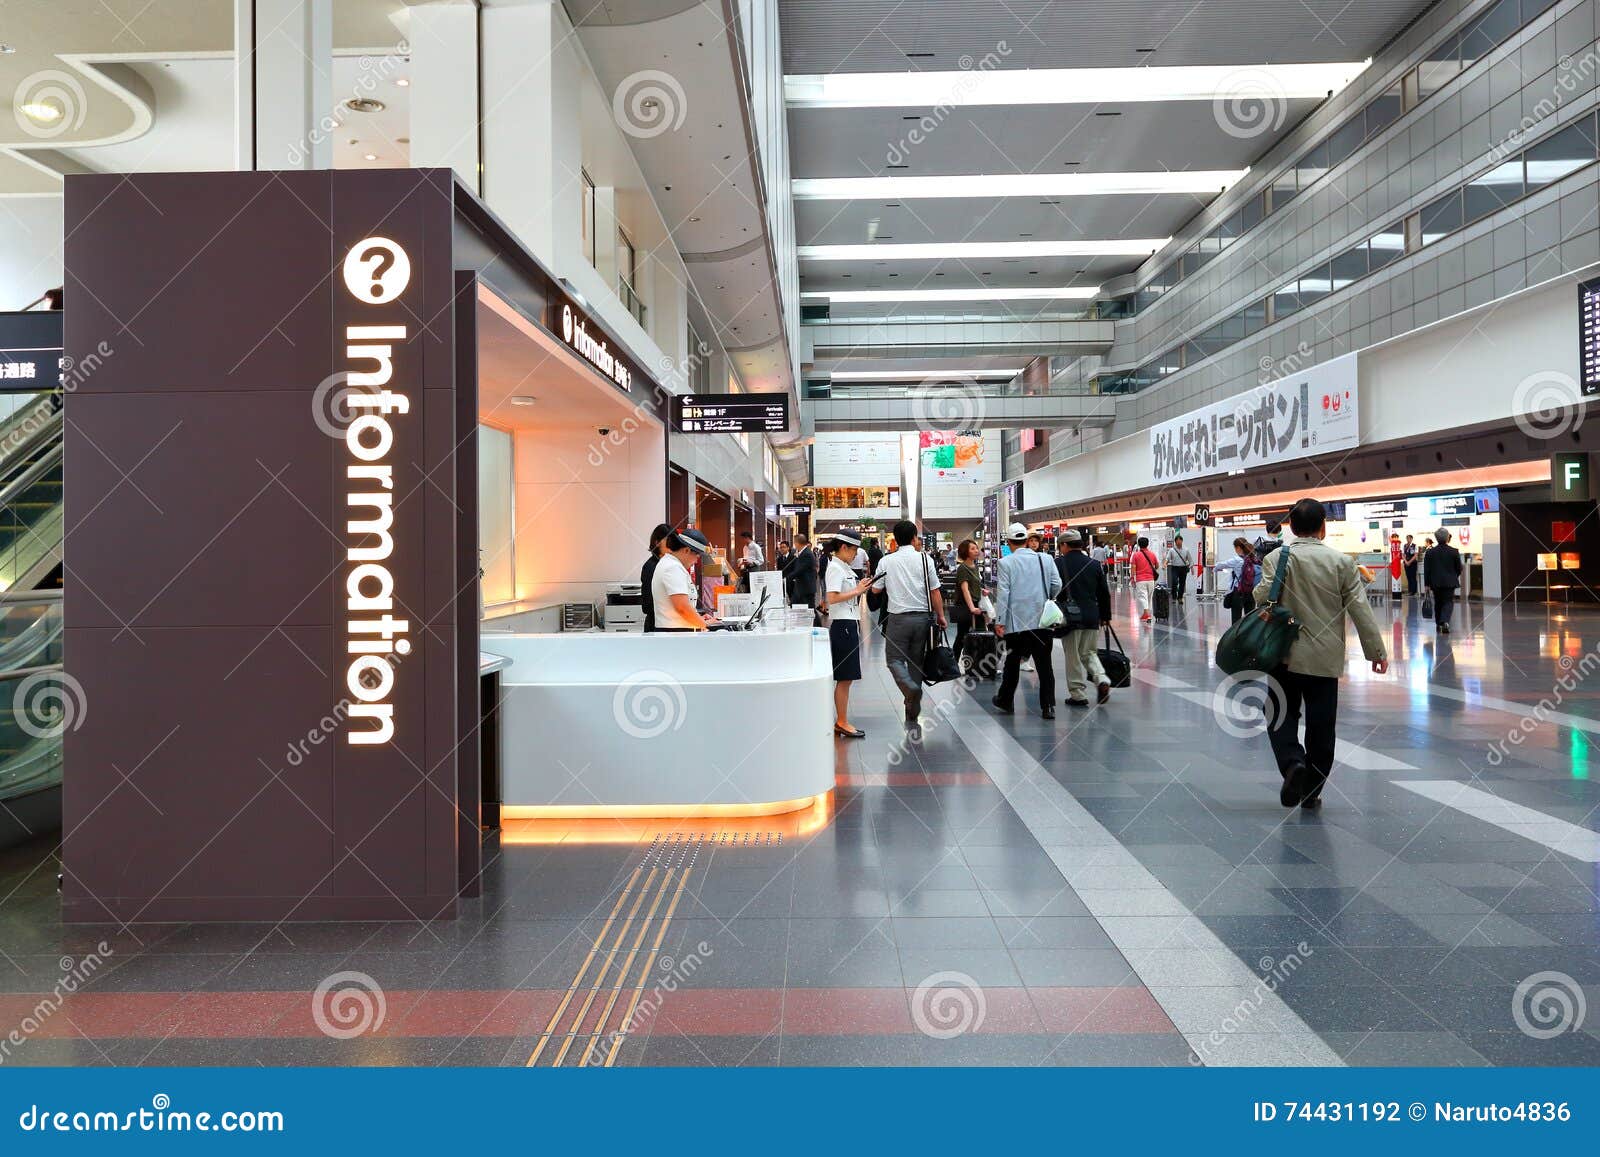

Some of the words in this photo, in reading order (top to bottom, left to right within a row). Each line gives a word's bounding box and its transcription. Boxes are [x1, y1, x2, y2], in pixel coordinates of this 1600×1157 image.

[0, 362, 36, 379] 通路
[1564, 462, 1580, 490] F
[1195, 508, 1209, 521] 60
[346, 325, 411, 744] Information
[1044, 527, 1053, 535] 54
